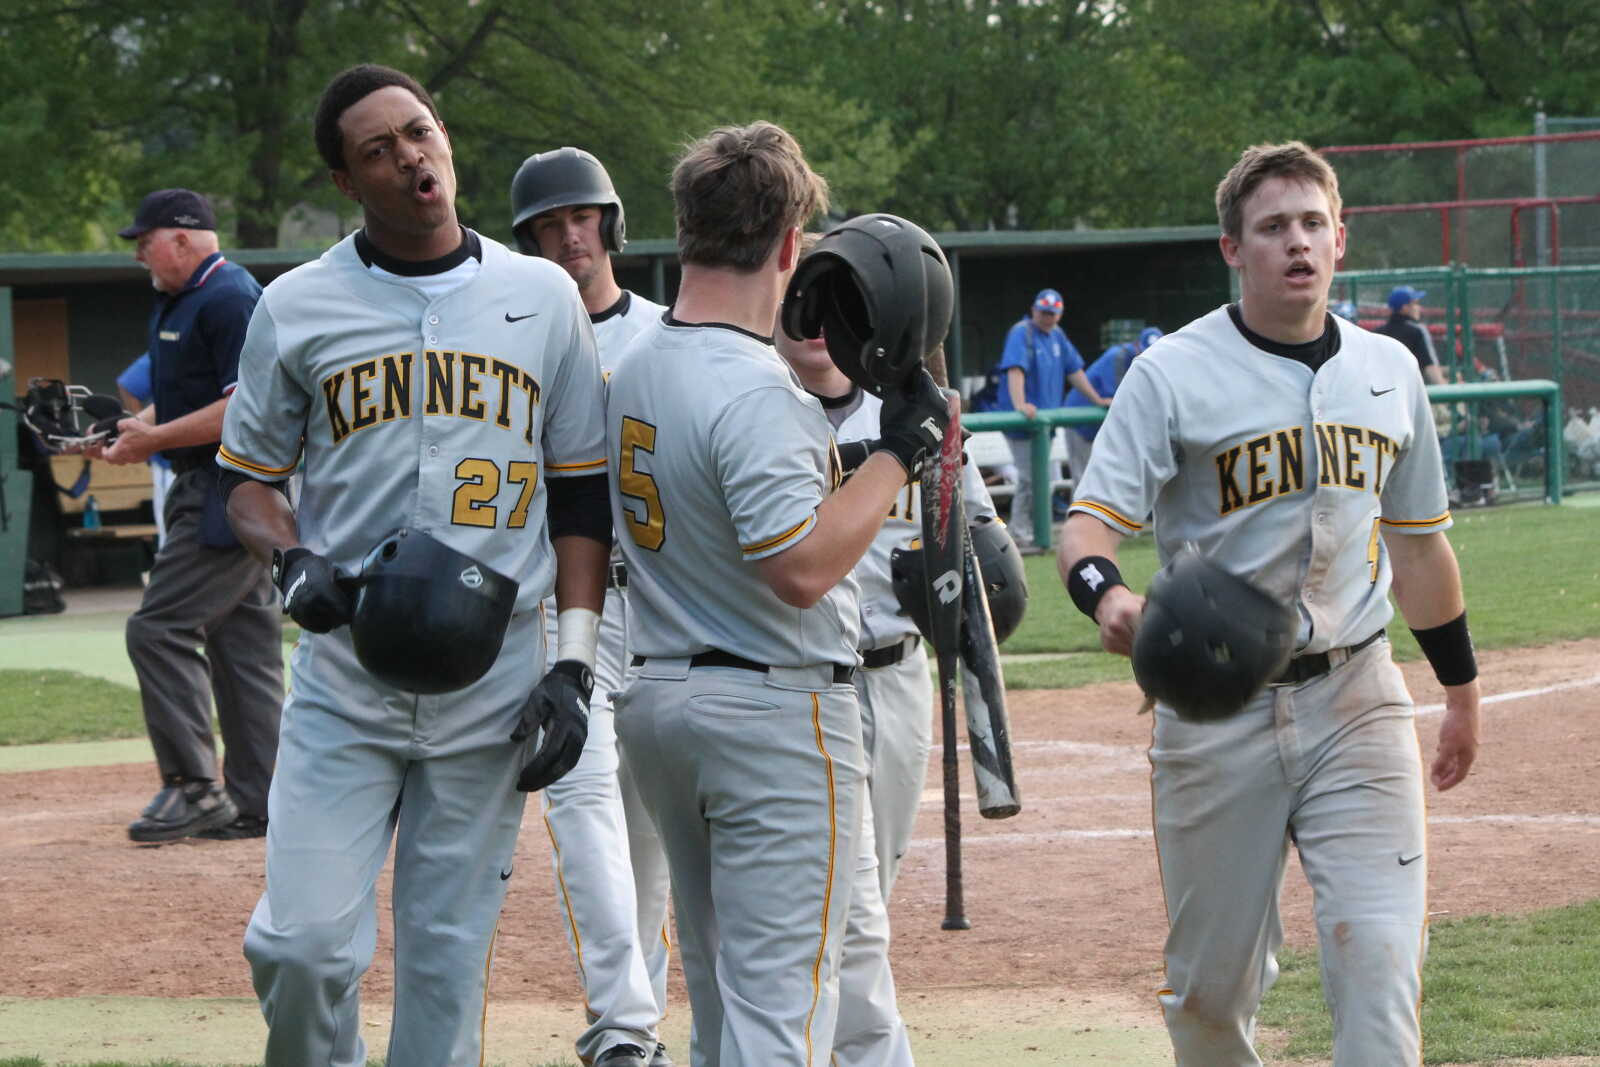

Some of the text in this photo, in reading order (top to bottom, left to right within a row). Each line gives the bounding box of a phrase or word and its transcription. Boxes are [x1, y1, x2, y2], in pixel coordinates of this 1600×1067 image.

[319, 349, 541, 446] KENNETT
[451, 457, 539, 529] 27
[618, 414, 666, 552] 5
